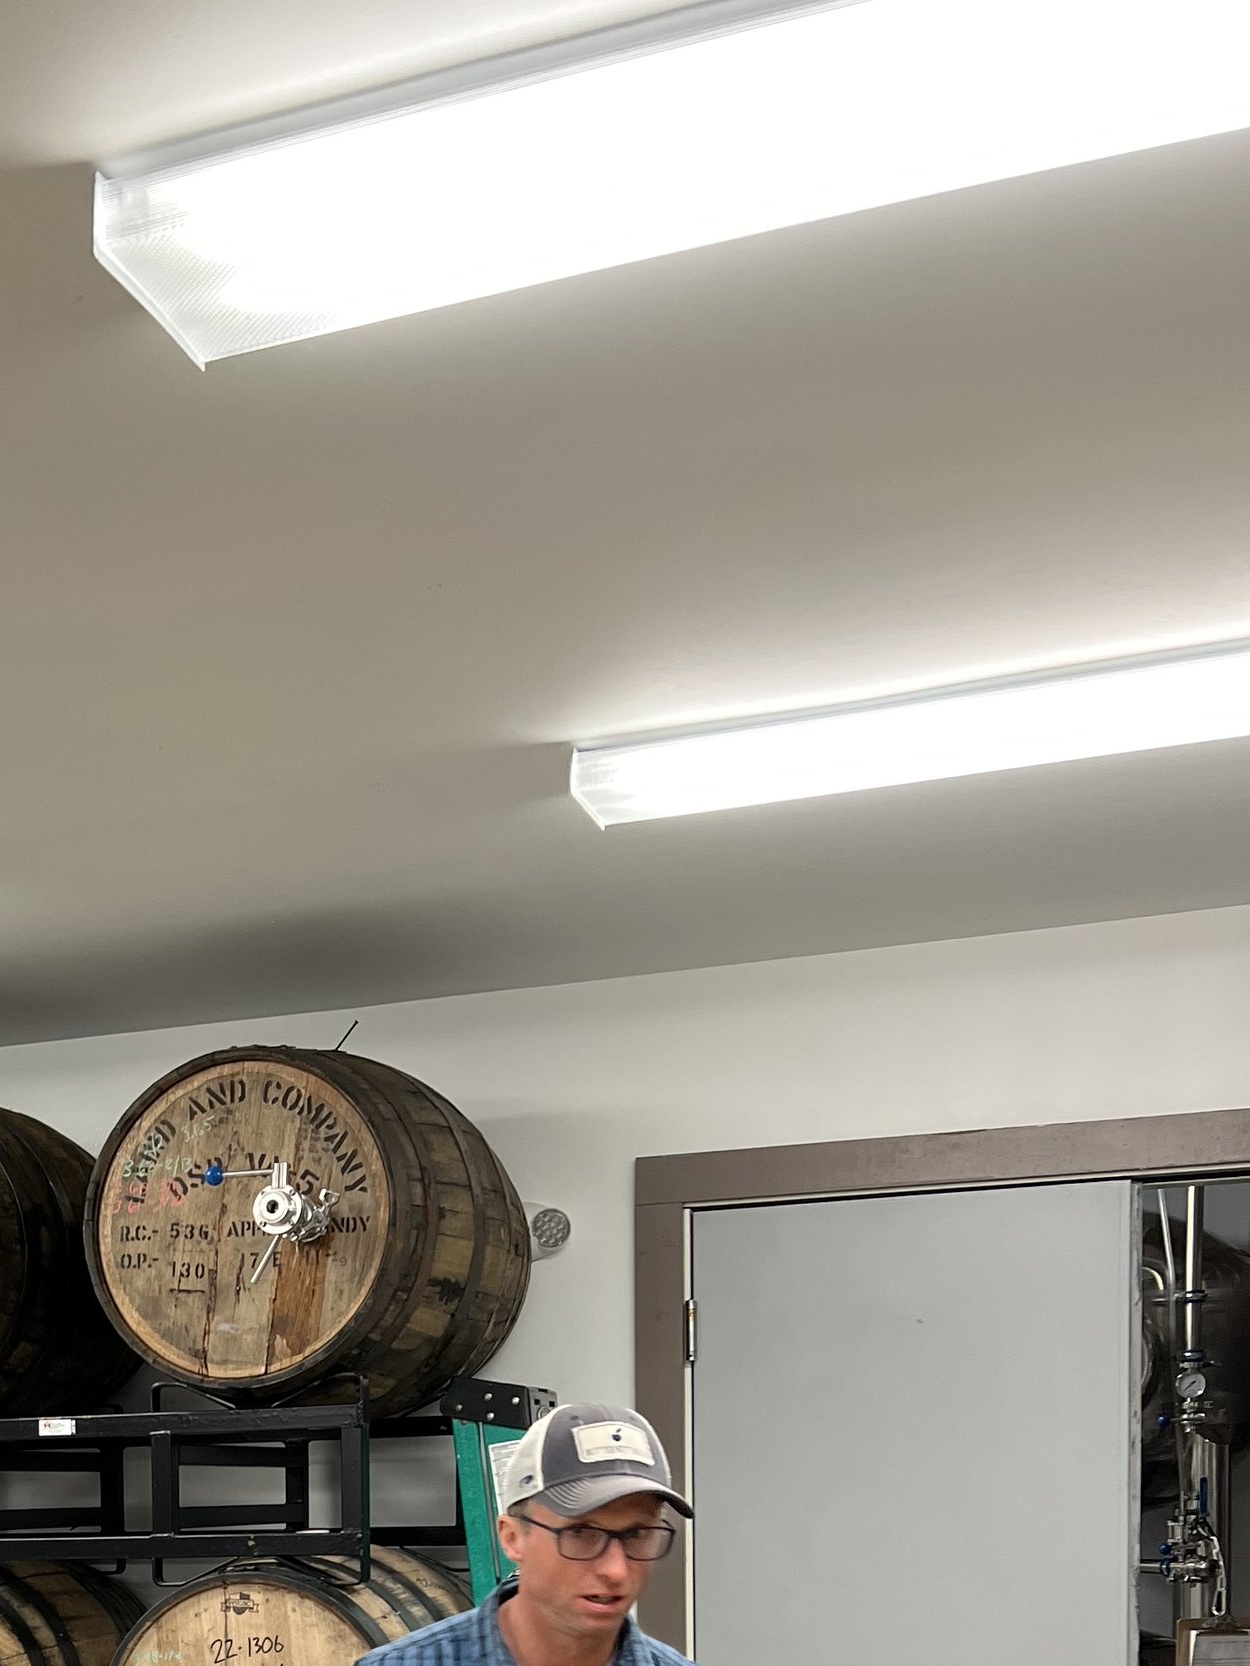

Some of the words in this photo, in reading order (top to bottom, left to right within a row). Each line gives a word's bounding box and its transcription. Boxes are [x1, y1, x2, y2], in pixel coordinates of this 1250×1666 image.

[188, 1079, 247, 1121] AND
[262, 1080, 369, 1193] COMPANY
[210, 1635, 285, 1664] 22-1306
